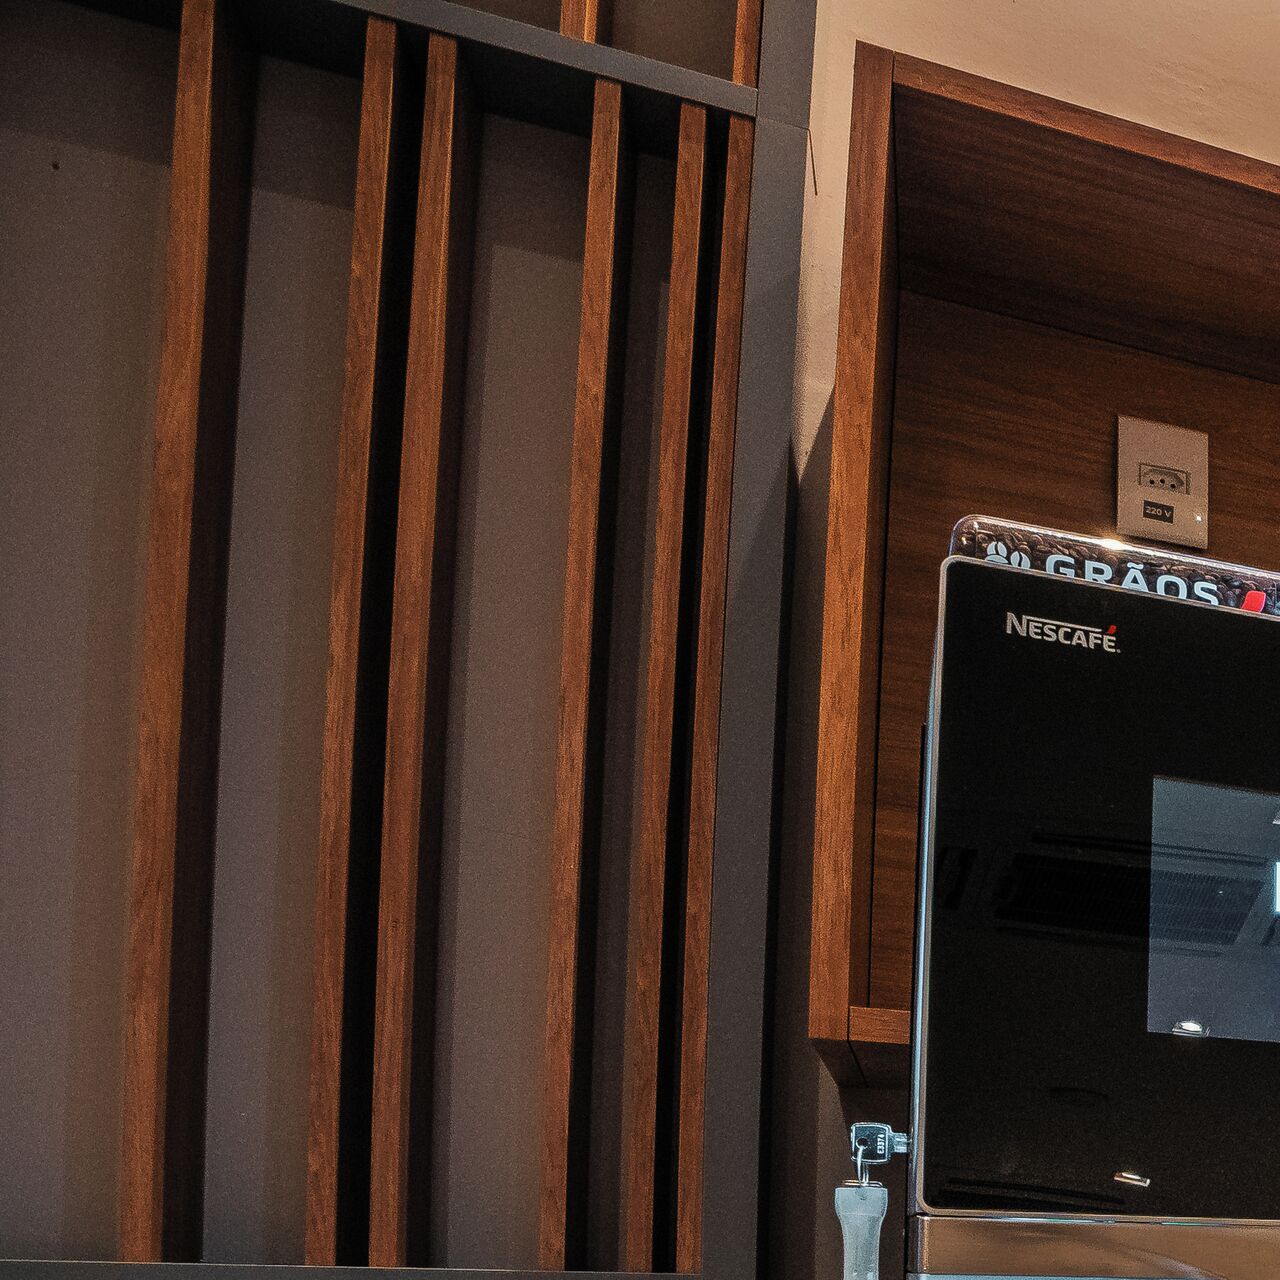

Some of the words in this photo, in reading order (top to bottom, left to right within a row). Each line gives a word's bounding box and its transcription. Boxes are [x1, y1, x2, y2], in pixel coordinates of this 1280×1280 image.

[1145, 505, 1163, 516] 220
[1164, 510, 1172, 518] V
[1046, 555, 1220, 606] GRÃOS
[1006, 611, 1118, 653] NESCAFÉ
